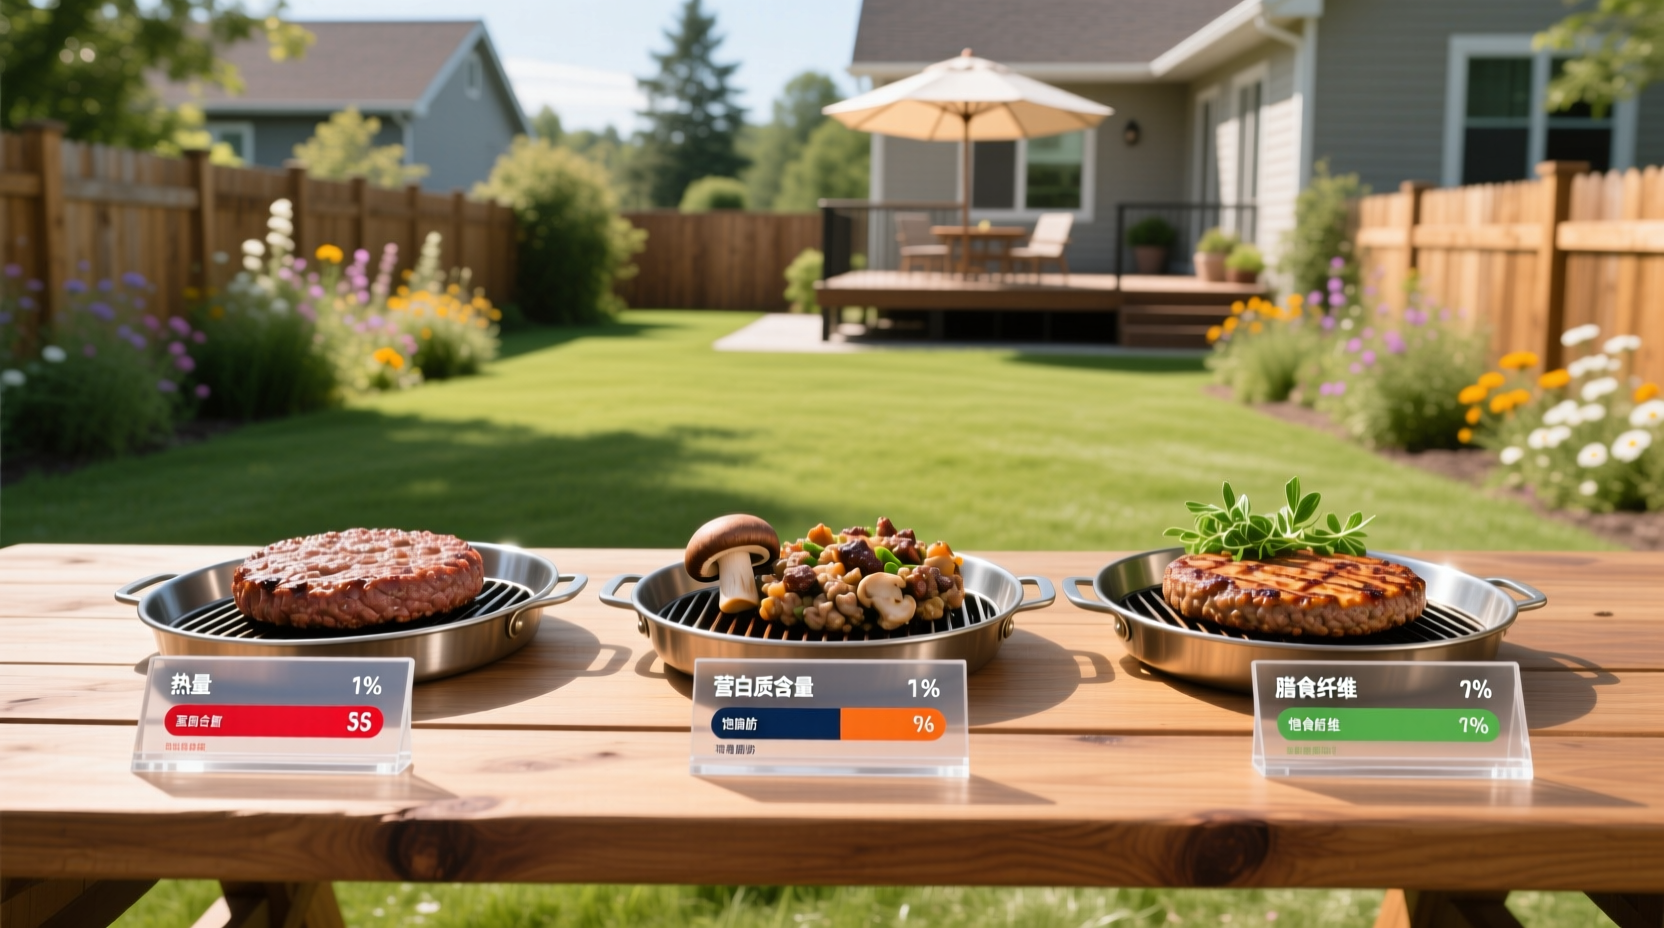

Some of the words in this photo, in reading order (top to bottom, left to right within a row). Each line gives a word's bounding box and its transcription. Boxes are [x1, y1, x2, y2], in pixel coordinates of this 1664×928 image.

[171, 672, 212, 695] 热量
[352, 676, 382, 695] 1%
[907, 678, 941, 698] 1%
